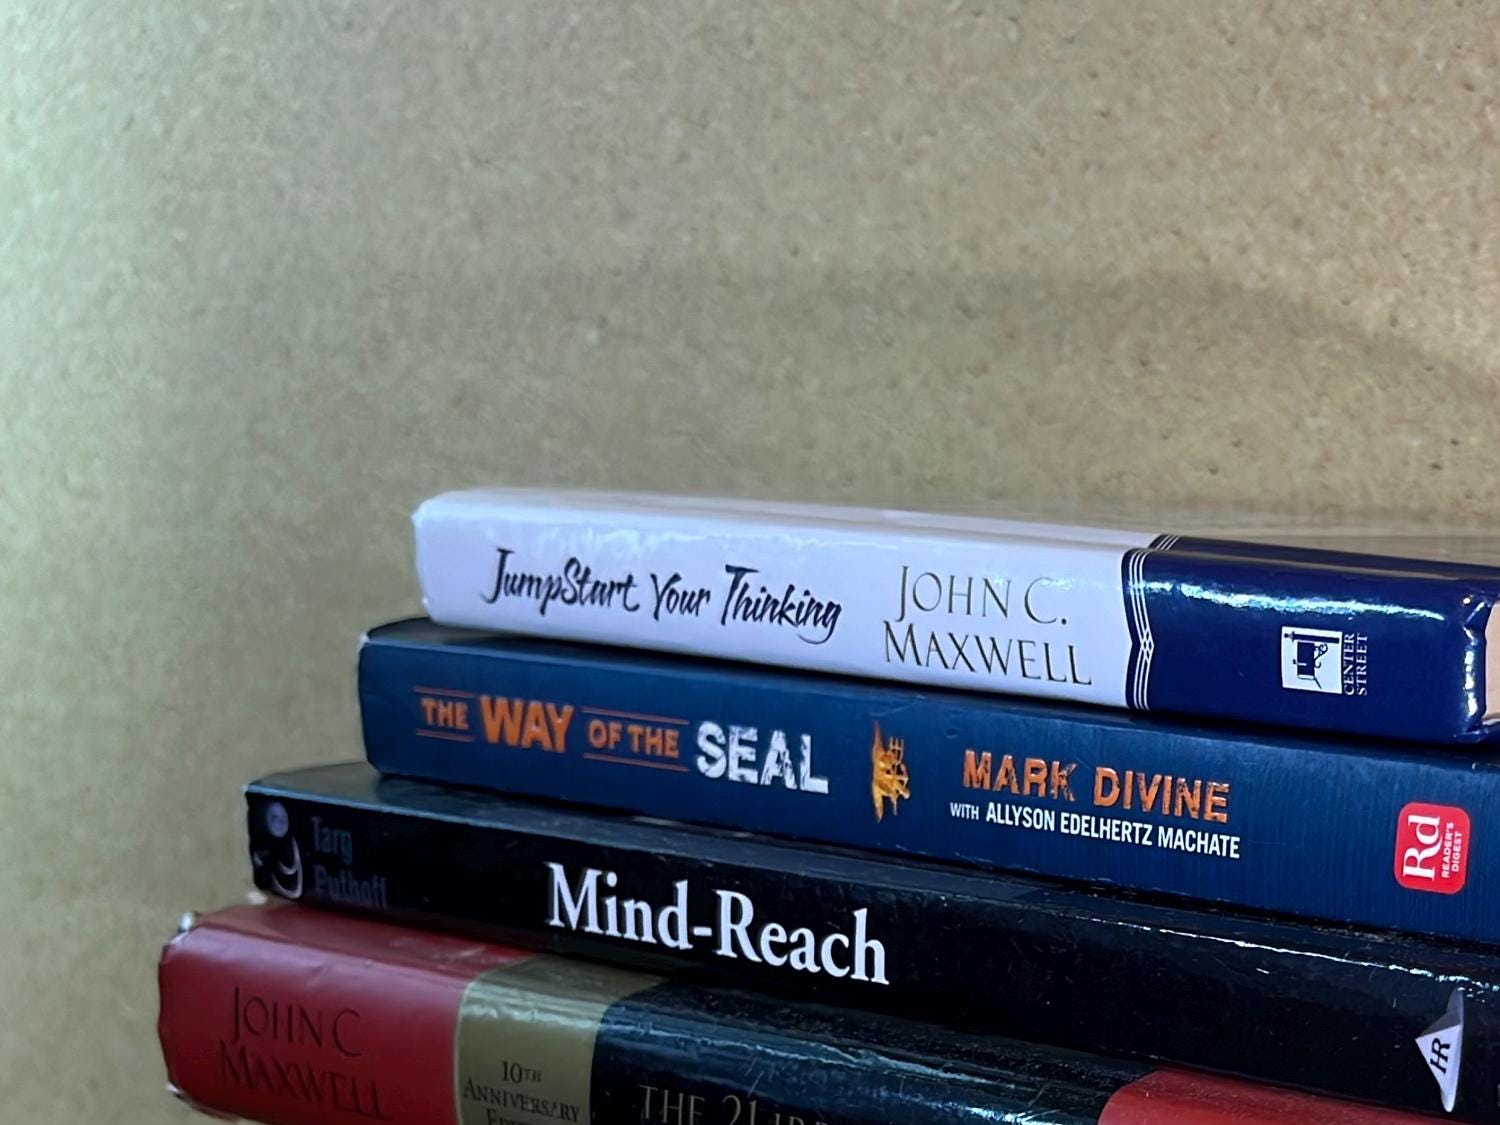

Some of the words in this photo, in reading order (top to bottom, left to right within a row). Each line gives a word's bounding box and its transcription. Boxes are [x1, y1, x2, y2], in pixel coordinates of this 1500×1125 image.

[481, 547, 641, 614] JumpStart
[651, 573, 711, 622] Your
[718, 565, 842, 645] Thinking
[895, 565, 1012, 623] JOHN
[1023, 576, 1069, 626] C.
[882, 620, 1092, 686] MAXWELL
[1343, 632, 1355, 696] CENTER
[1356, 632, 1368, 696] STREET
[420, 697, 469, 731] THE
[479, 693, 574, 754] WAY
[587, 718, 621, 749] OF
[628, 723, 680, 759] THE
[695, 720, 829, 794] SEAL
[962, 748, 1078, 802] MARK
[1092, 766, 1231, 823] DIVINE
[949, 801, 979, 821] WITH
[985, 801, 1056, 832] ALLYSON
[1059, 811, 1153, 846] EDELHERTZ
[1157, 826, 1241, 859] MACHATE
[1402, 814, 1443, 881] Rd
[1441, 821, 1454, 878] READER'S
[1451, 831, 1463, 872] DIGEST
[544, 861, 889, 985] Mind-Reach
[231, 986, 324, 1048] JOHN
[332, 1008, 363, 1058] C
[219, 1039, 393, 1122] MAXWELL
[463, 1076, 580, 1123] ANNIVERSARY
